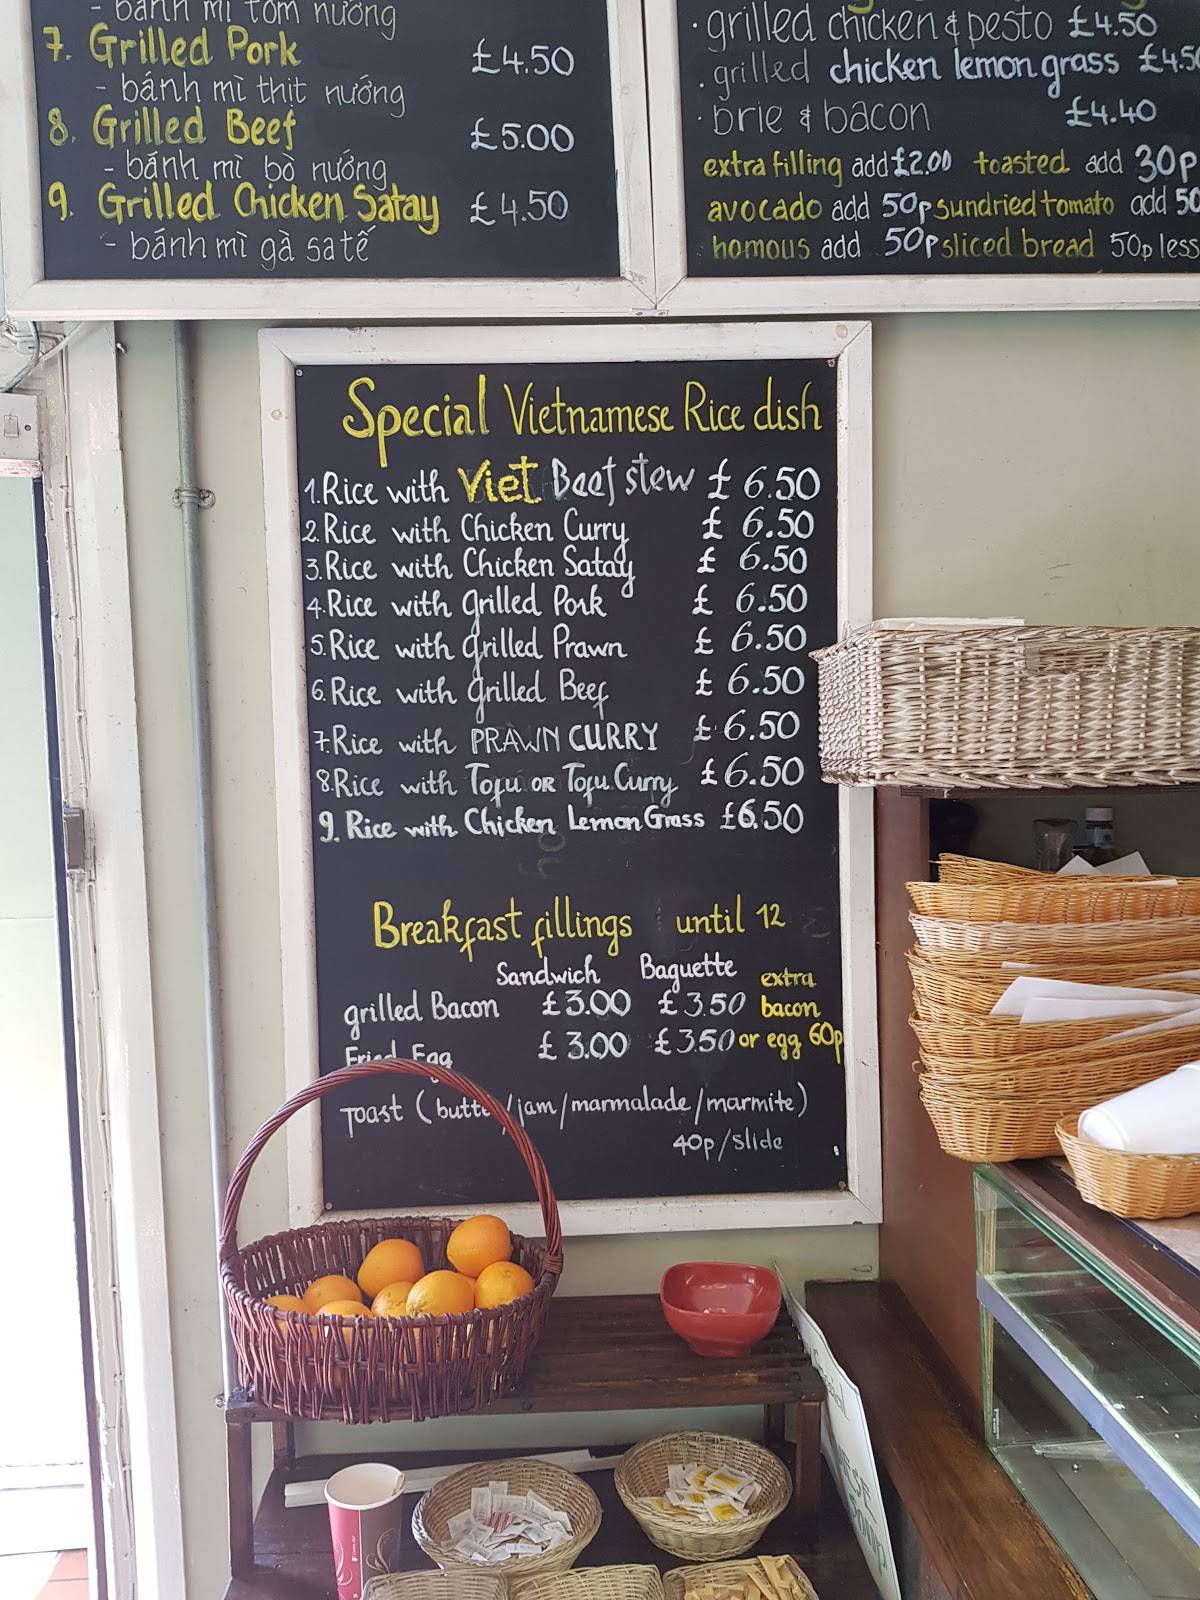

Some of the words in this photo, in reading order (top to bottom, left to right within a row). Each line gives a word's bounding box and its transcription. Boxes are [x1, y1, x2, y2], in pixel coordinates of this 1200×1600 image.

[89, 22, 213, 69] Grilled
[227, 25, 301, 66] Pork
[472, 38, 575, 76] £4.50
[707, 1, 817, 53] grilled
[828, 5, 939, 42] chicken
[967, 5, 1052, 49] pesto
[1068, 4, 1158, 38] £4.50
[713, 48, 810, 102] grilled
[829, 47, 942, 85] chicken
[93, 104, 206, 149] Grilled
[227, 107, 296, 150] Beef
[470, 117, 575, 152] £5.00
[713, 101, 783, 136] brie
[823, 99, 931, 135] bacon
[1065, 95, 1158, 128] £4.40
[703, 150, 767, 178] extra
[772, 149, 844, 188] filling
[851, 150, 888, 178] add
[973, 148, 1071, 176] toasted
[1085, 148, 1124, 175] add
[1134, 144, 1199, 184] 30p
[98, 180, 221, 224] Grilled
[233, 181, 348, 224] Chicken
[353, 183, 440, 235] Satay
[707, 191, 823, 222] avocado
[831, 191, 870, 222] add
[881, 191, 932, 225] 50p
[1130, 185, 1167, 217] add
[712, 235, 811, 261] homous
[820, 230, 861, 261] add
[884, 226, 939, 260] 50p
[941, 227, 1012, 260] sliced
[1021, 227, 1096, 260] bread
[1109, 231, 1152, 262] 50p
[1159, 232, 1200, 259] less
[342, 374, 490, 469] Special
[503, 381, 675, 436] Vietnamese
[684, 381, 745, 433] Rice
[753, 376, 822, 432] dish
[386, 468, 450, 505] with
[457, 455, 542, 504] Viet
[551, 455, 617, 507] Beef
[625, 452, 695, 496] stew
[391, 515, 451, 544] with
[460, 512, 554, 543] Chicken
[563, 507, 630, 563] Curry
[391, 552, 453, 580] with
[463, 546, 554, 578] Chicken
[563, 544, 635, 599] Satay
[391, 589, 453, 618] with
[553, 584, 608, 618] Pork
[394, 631, 455, 661] with
[553, 623, 628, 659] Prawn
[396, 675, 458, 705] with
[560, 668, 609, 720] Beef
[399, 727, 457, 755] with
[471, 726, 560, 754] PRAWN
[568, 722, 659, 752] CURRY
[400, 769, 458, 796] with
[465, 762, 522, 808] Tofu
[614, 762, 678, 808] Curry
[346, 809, 398, 840] Rice
[404, 814, 458, 838] with
[464, 806, 557, 837] Chicken
[374, 896, 523, 962] Breakfast
[531, 895, 632, 957] fillings
[676, 894, 745, 935] until
[756, 903, 786, 929] 12
[497, 954, 601, 986] Sandwich
[640, 952, 737, 993] Baguette
[761, 968, 817, 989] extra
[344, 989, 423, 1040] grilled
[431, 990, 500, 1020] Bacon
[761, 995, 821, 1018] bacon
[738, 1032, 760, 1048] or
[767, 1031, 802, 1061] egg
[809, 1021, 843, 1064] 60p
